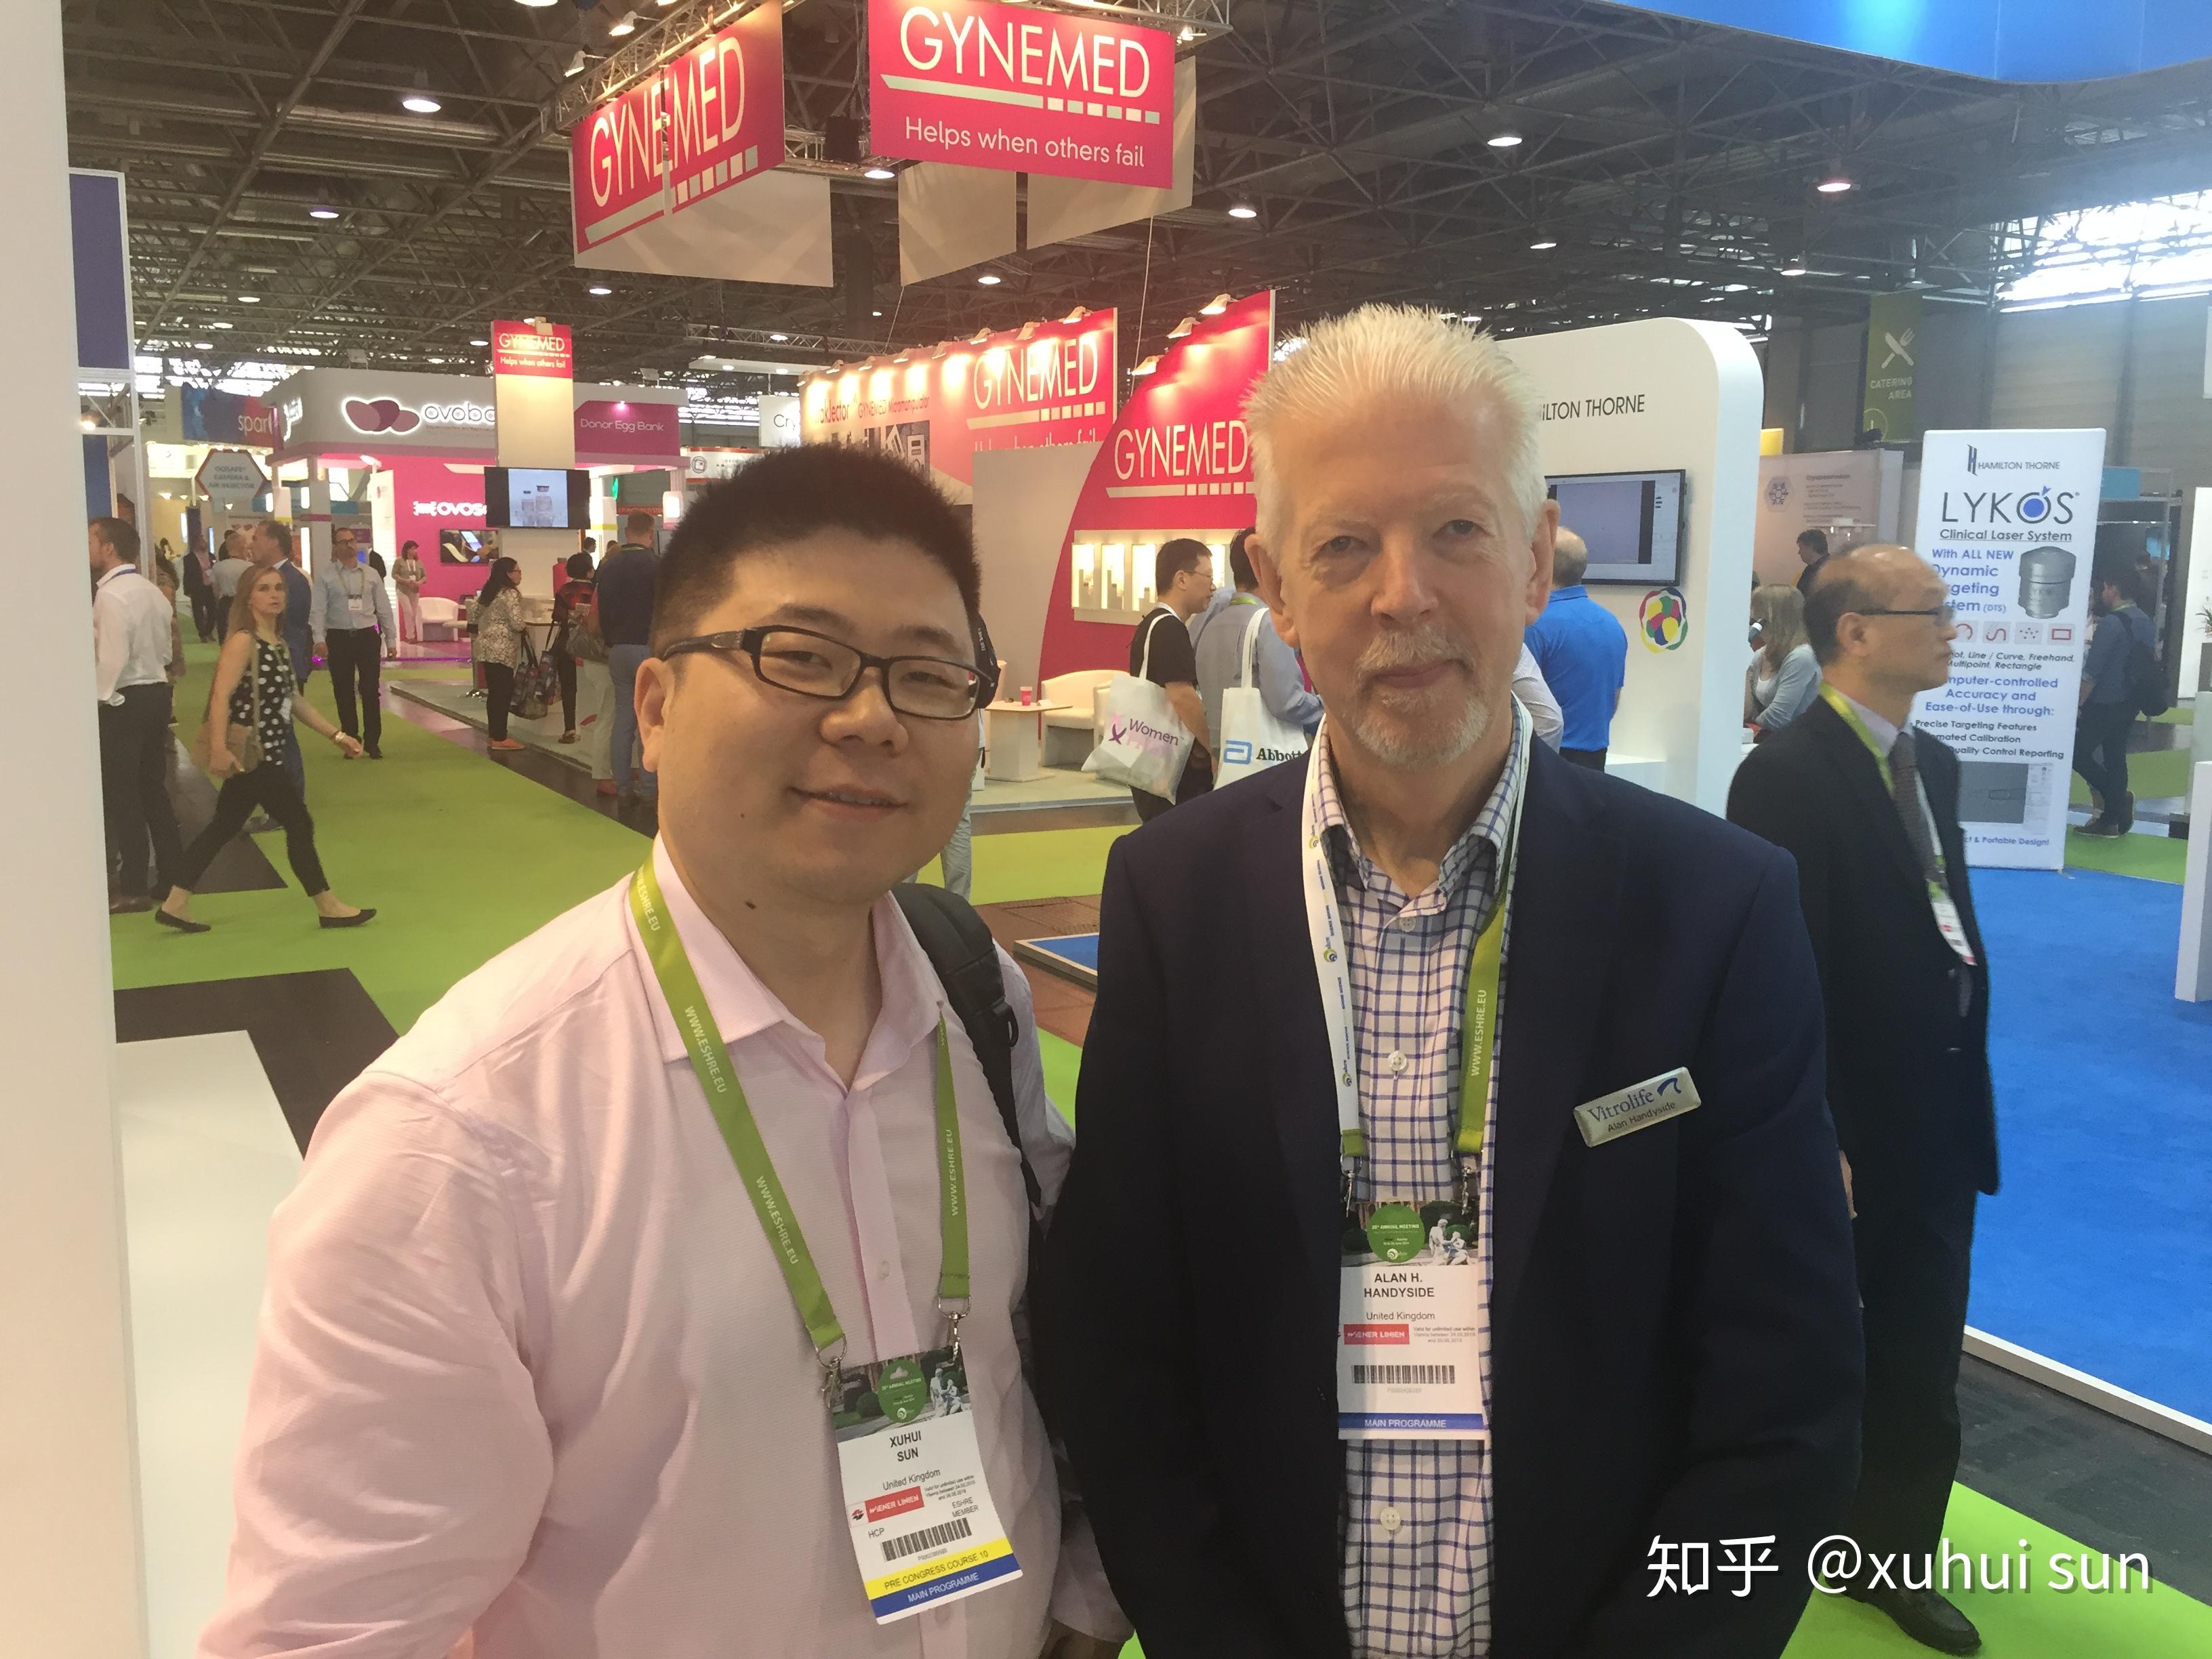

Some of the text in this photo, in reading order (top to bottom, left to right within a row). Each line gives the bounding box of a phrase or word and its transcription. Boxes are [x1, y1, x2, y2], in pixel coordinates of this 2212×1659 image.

[901, 6, 1150, 99] GYNEMED
[590, 37, 745, 207] GYNEMED
[905, 117, 1145, 168] Helps when others fail
[973, 336, 1098, 411] GYNEMED
[1870, 376, 1913, 389] CATERING
[1888, 390, 1912, 401] AREA
[1540, 394, 1645, 422] ILTON THORNE
[580, 418, 664, 433] Donor Egg Bank
[1114, 419, 1249, 480] GYNEMED
[1978, 462, 2061, 470] HAMILTON THORNE
[1940, 529, 2072, 542] Clinical Laser System
[1931, 548, 2014, 560] With ALL NEW
[1947, 582, 1999, 597] geting
[1983, 604, 2007, 613] (DTS)
[1952, 651, 1965, 659] ot,
[1996, 652, 2025, 661] Curve,
[2029, 653, 2075, 662] Freehand,
[1994, 661, 2042, 672] Rectangle
[1946, 689, 2036, 702] Accuracy and
[1925, 701, 2055, 718] Ease-of-Use through:
[1915, 720, 2037, 732] Precise Targeting Features
[1969, 734, 2021, 743] Calibration
[1256, 747, 1304, 762] Abbott
[1982, 747, 2016, 756] Control
[2020, 748, 2064, 760] Reporting
[1982, 836, 2017, 844] Portable
[1471, 989, 1488, 1077] WWW.ESHRE.EU
[684, 1005, 727, 1094] WWW.ESHRE.EU
[1587, 1089, 1655, 1122] Vitrolife
[1607, 1101, 1676, 1132] Alan Handyside
[945, 1128, 958, 1216] WWW.ESHRE.EU
[755, 1175, 799, 1265] WWW.ESHRE.EU
[1374, 1272, 1423, 1284] ALAN H.
[1364, 1286, 1435, 1298] HANDYSIDE
[1366, 1311, 1435, 1322] United Kingdom
[1347, 1330, 1406, 1339] WIENER LINIEN
[1364, 1418, 1447, 1428] MAIN PROGRAMME
[889, 1430, 922, 1448] XUHUI
[897, 1447, 919, 1462] SUN
[882, 1468, 941, 1491] United Kingdom
[869, 1494, 920, 1516] WIENER LINIEN
[951, 1496, 974, 1509] ESHRE
[951, 1504, 979, 1518] MEMBER
[868, 1528, 885, 1539] HCP
[884, 1550, 989, 1591] PRE CONGRESS COURSE 10
[907, 1572, 980, 1603] MAIN PROGRAMME
